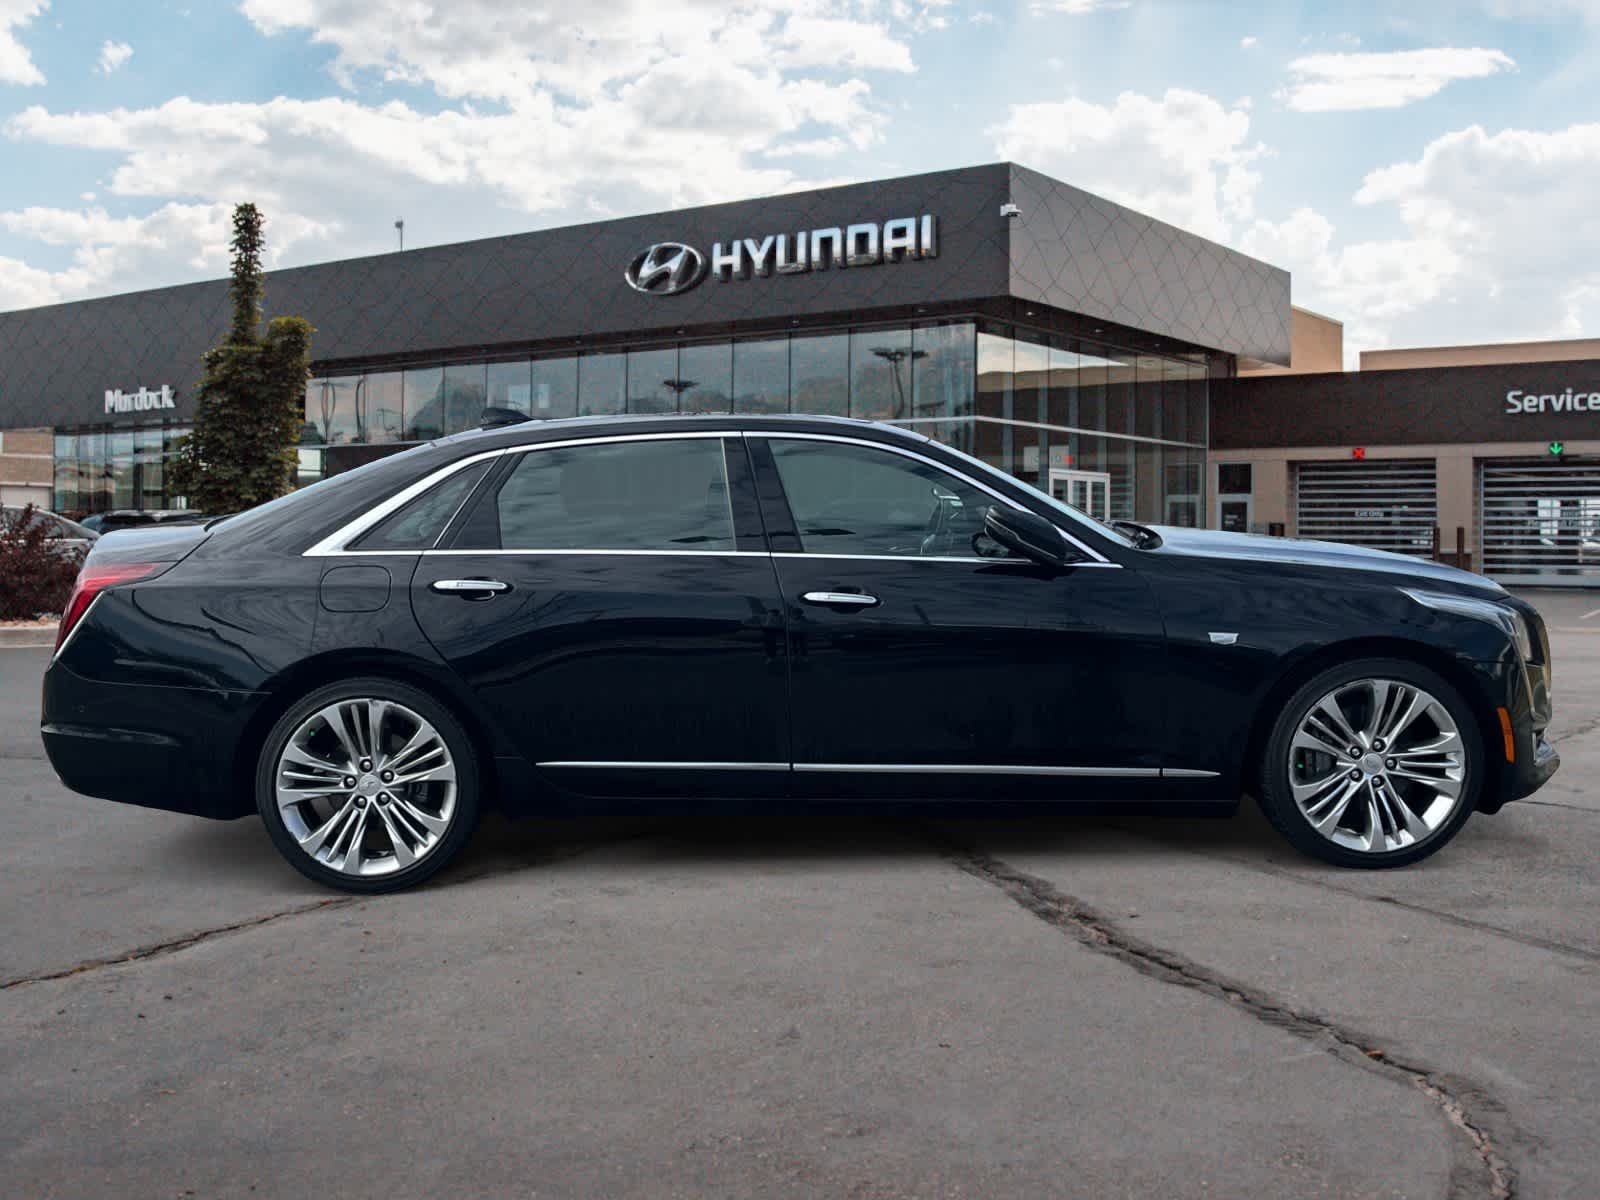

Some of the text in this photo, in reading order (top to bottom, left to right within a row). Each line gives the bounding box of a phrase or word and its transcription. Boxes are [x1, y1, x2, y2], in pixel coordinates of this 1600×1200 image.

[711, 214, 936, 281] HYUNDAI
[104, 384, 176, 413] Murdock
[1505, 388, 1600, 413] Service
